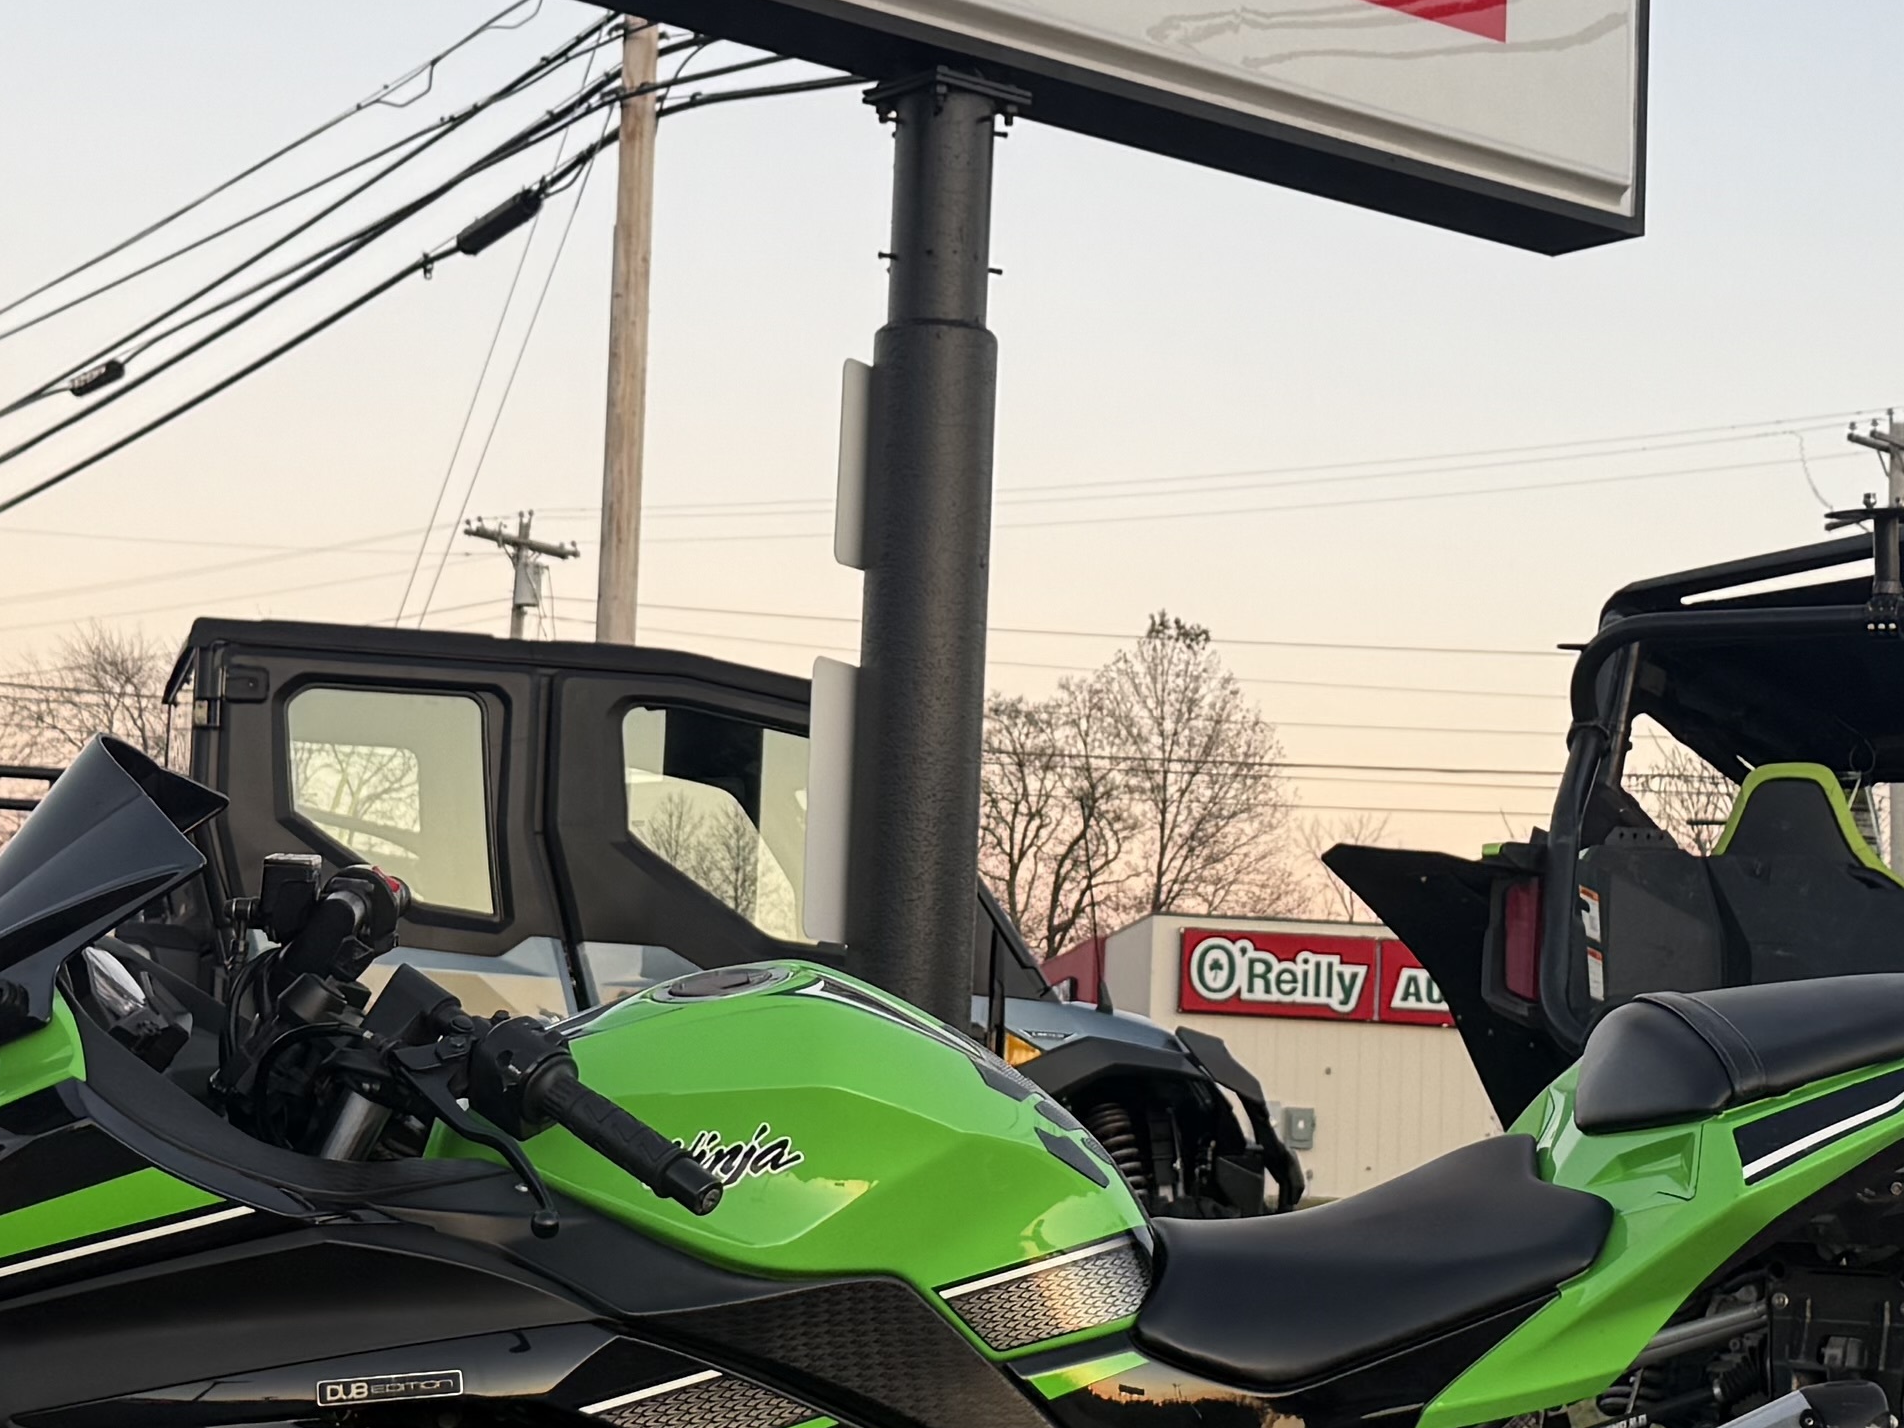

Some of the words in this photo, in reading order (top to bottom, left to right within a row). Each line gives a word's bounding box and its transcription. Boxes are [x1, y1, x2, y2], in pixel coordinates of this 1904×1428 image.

[1193, 940, 1363, 1009] O'Reilly
[672, 1123, 804, 1189] inja
[325, 1381, 370, 1402] DUB
